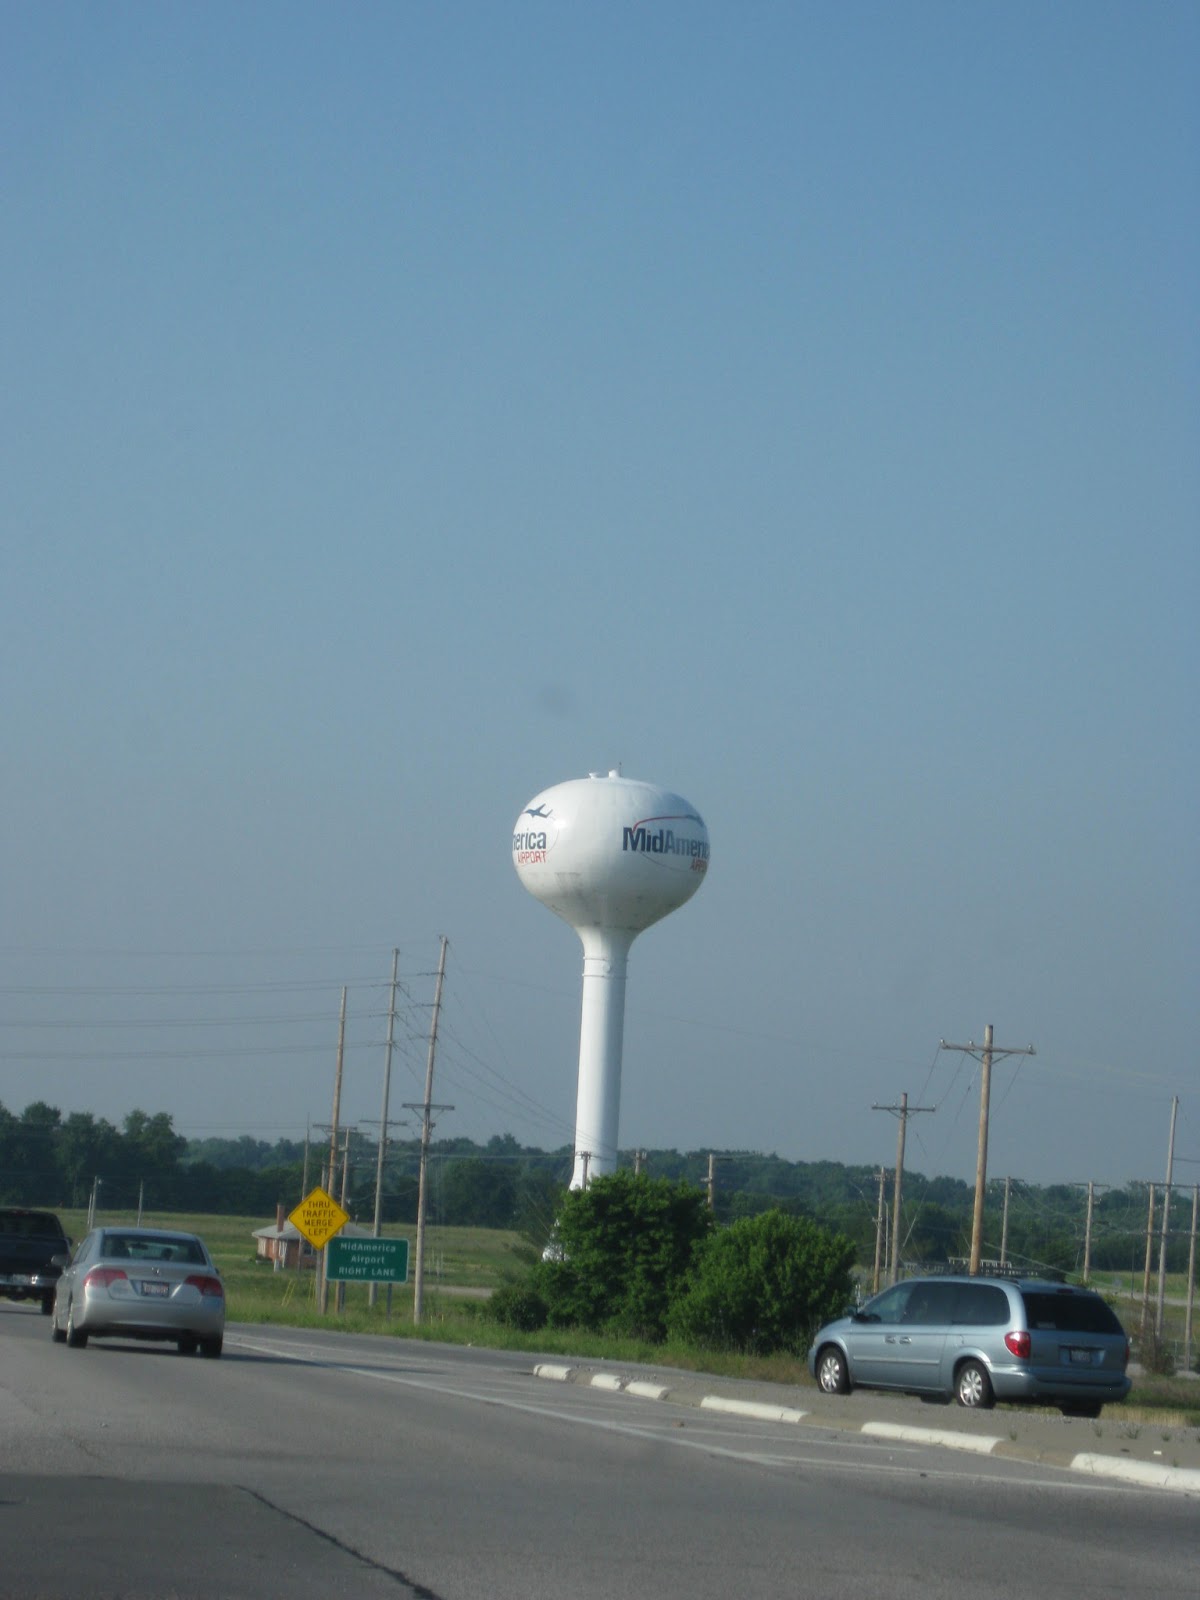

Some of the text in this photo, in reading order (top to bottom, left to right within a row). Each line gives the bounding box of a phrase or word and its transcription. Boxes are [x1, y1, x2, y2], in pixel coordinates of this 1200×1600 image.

[302, 1210, 337, 1218] TRAFFIC
[304, 1219, 333, 1227] MERGE
[308, 1228, 329, 1236] LEFT
[340, 1242, 396, 1252] MidAmerica
[351, 1256, 385, 1265] Airport
[338, 1266, 396, 1277] RIGHT LANE
